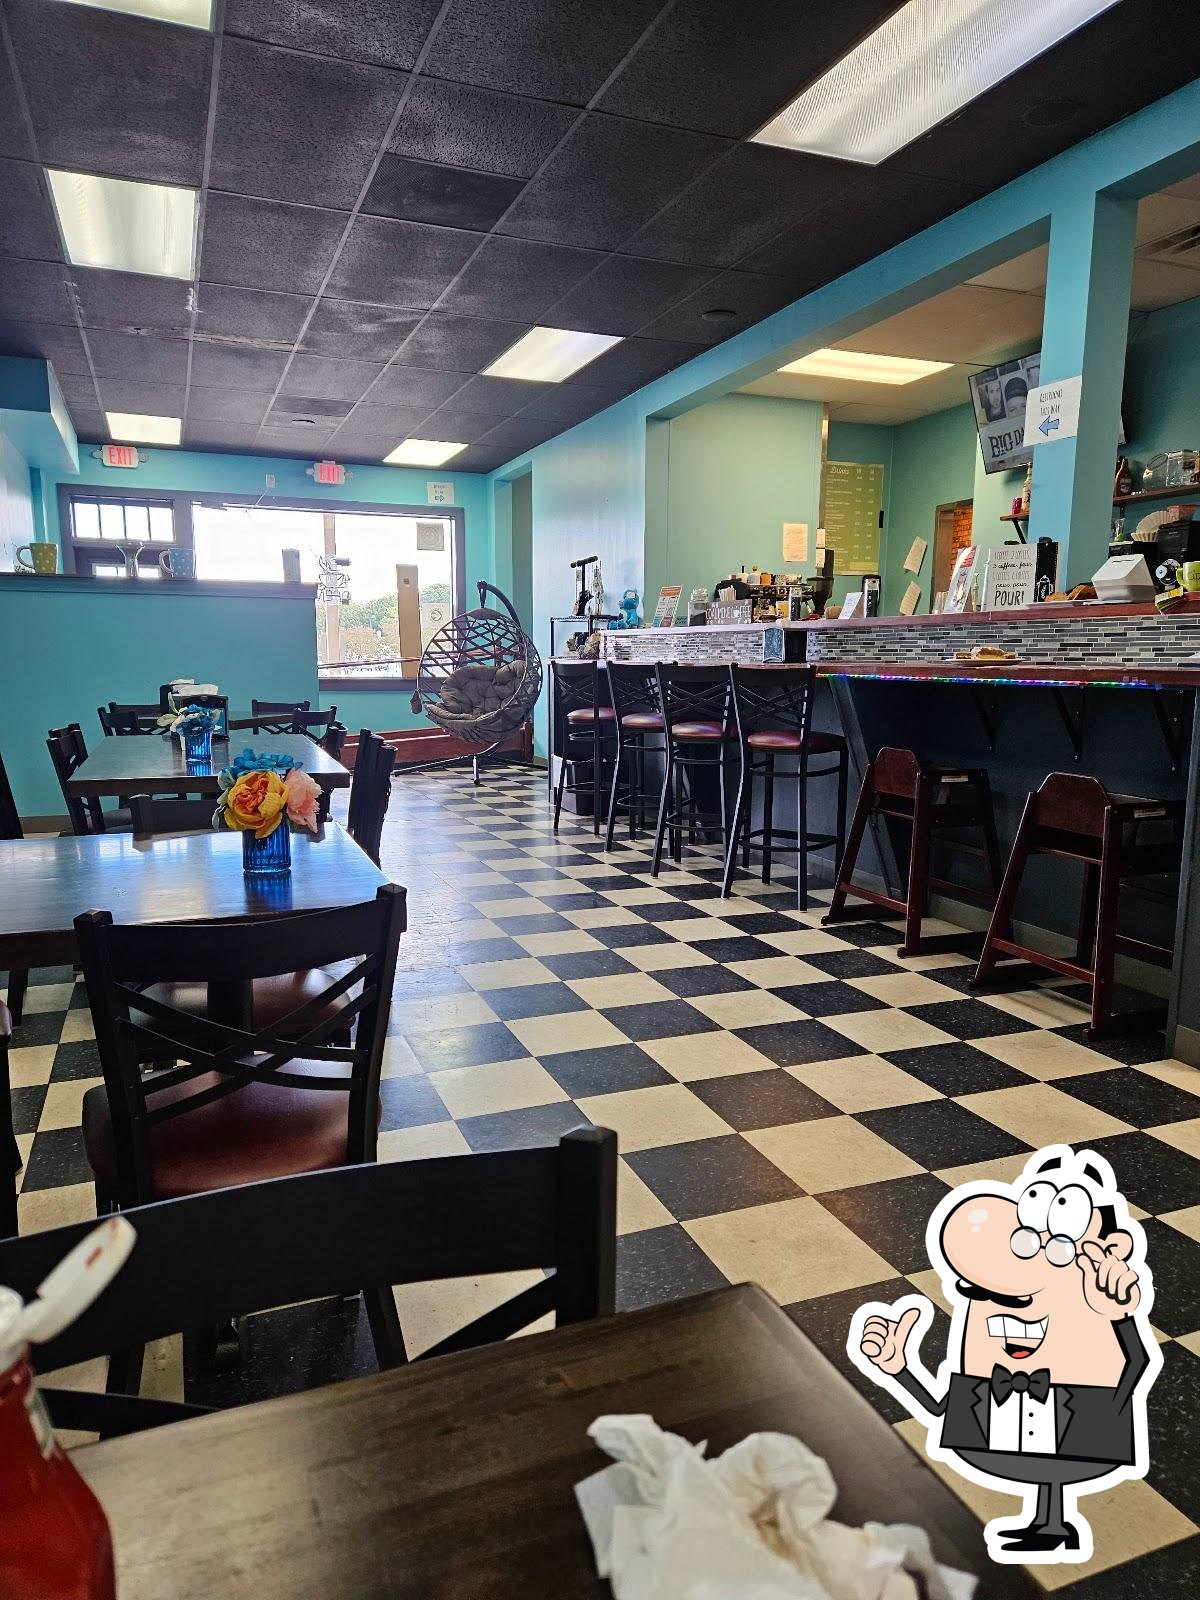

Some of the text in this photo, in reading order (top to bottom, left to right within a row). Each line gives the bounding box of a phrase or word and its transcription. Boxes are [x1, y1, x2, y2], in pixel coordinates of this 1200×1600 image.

[988, 432, 1014, 458] BIG
[108, 447, 132, 466] EXIT
[319, 464, 341, 482] EXIT
[994, 590, 1025, 607] POUR!
